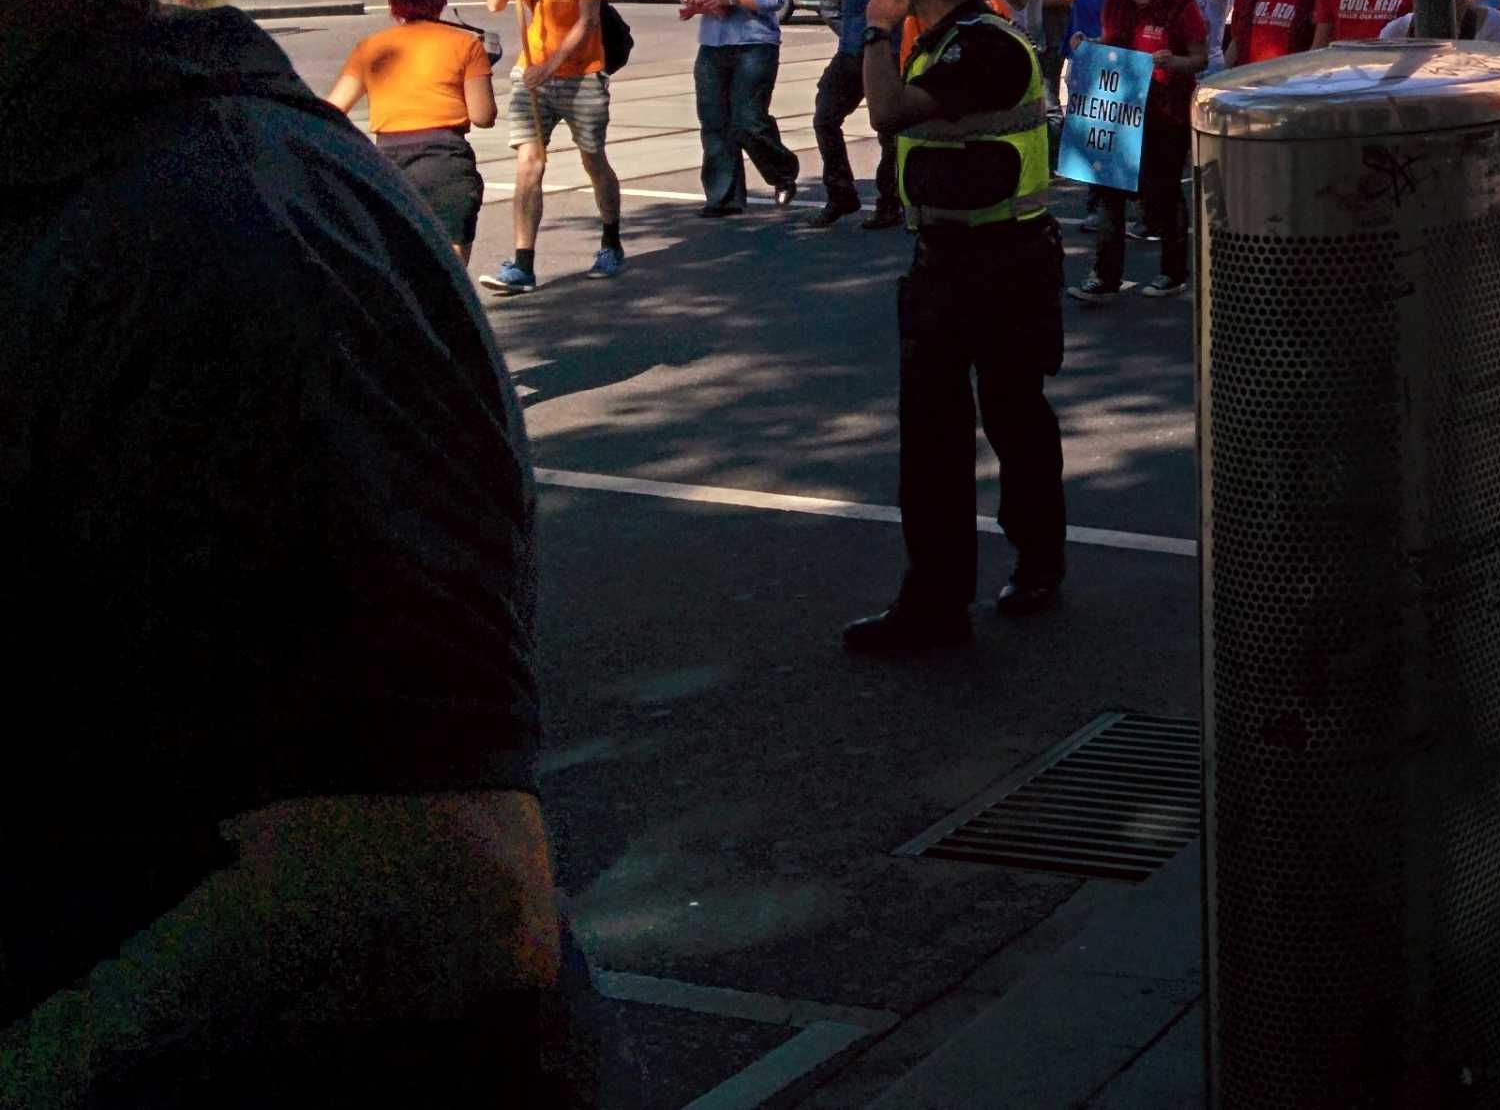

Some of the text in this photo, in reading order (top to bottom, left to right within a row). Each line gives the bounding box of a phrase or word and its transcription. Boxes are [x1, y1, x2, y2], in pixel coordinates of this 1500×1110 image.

[1099, 68, 1119, 93] NO
[1069, 98, 1142, 128] SILENCING
[1086, 127, 1117, 154] ACT
